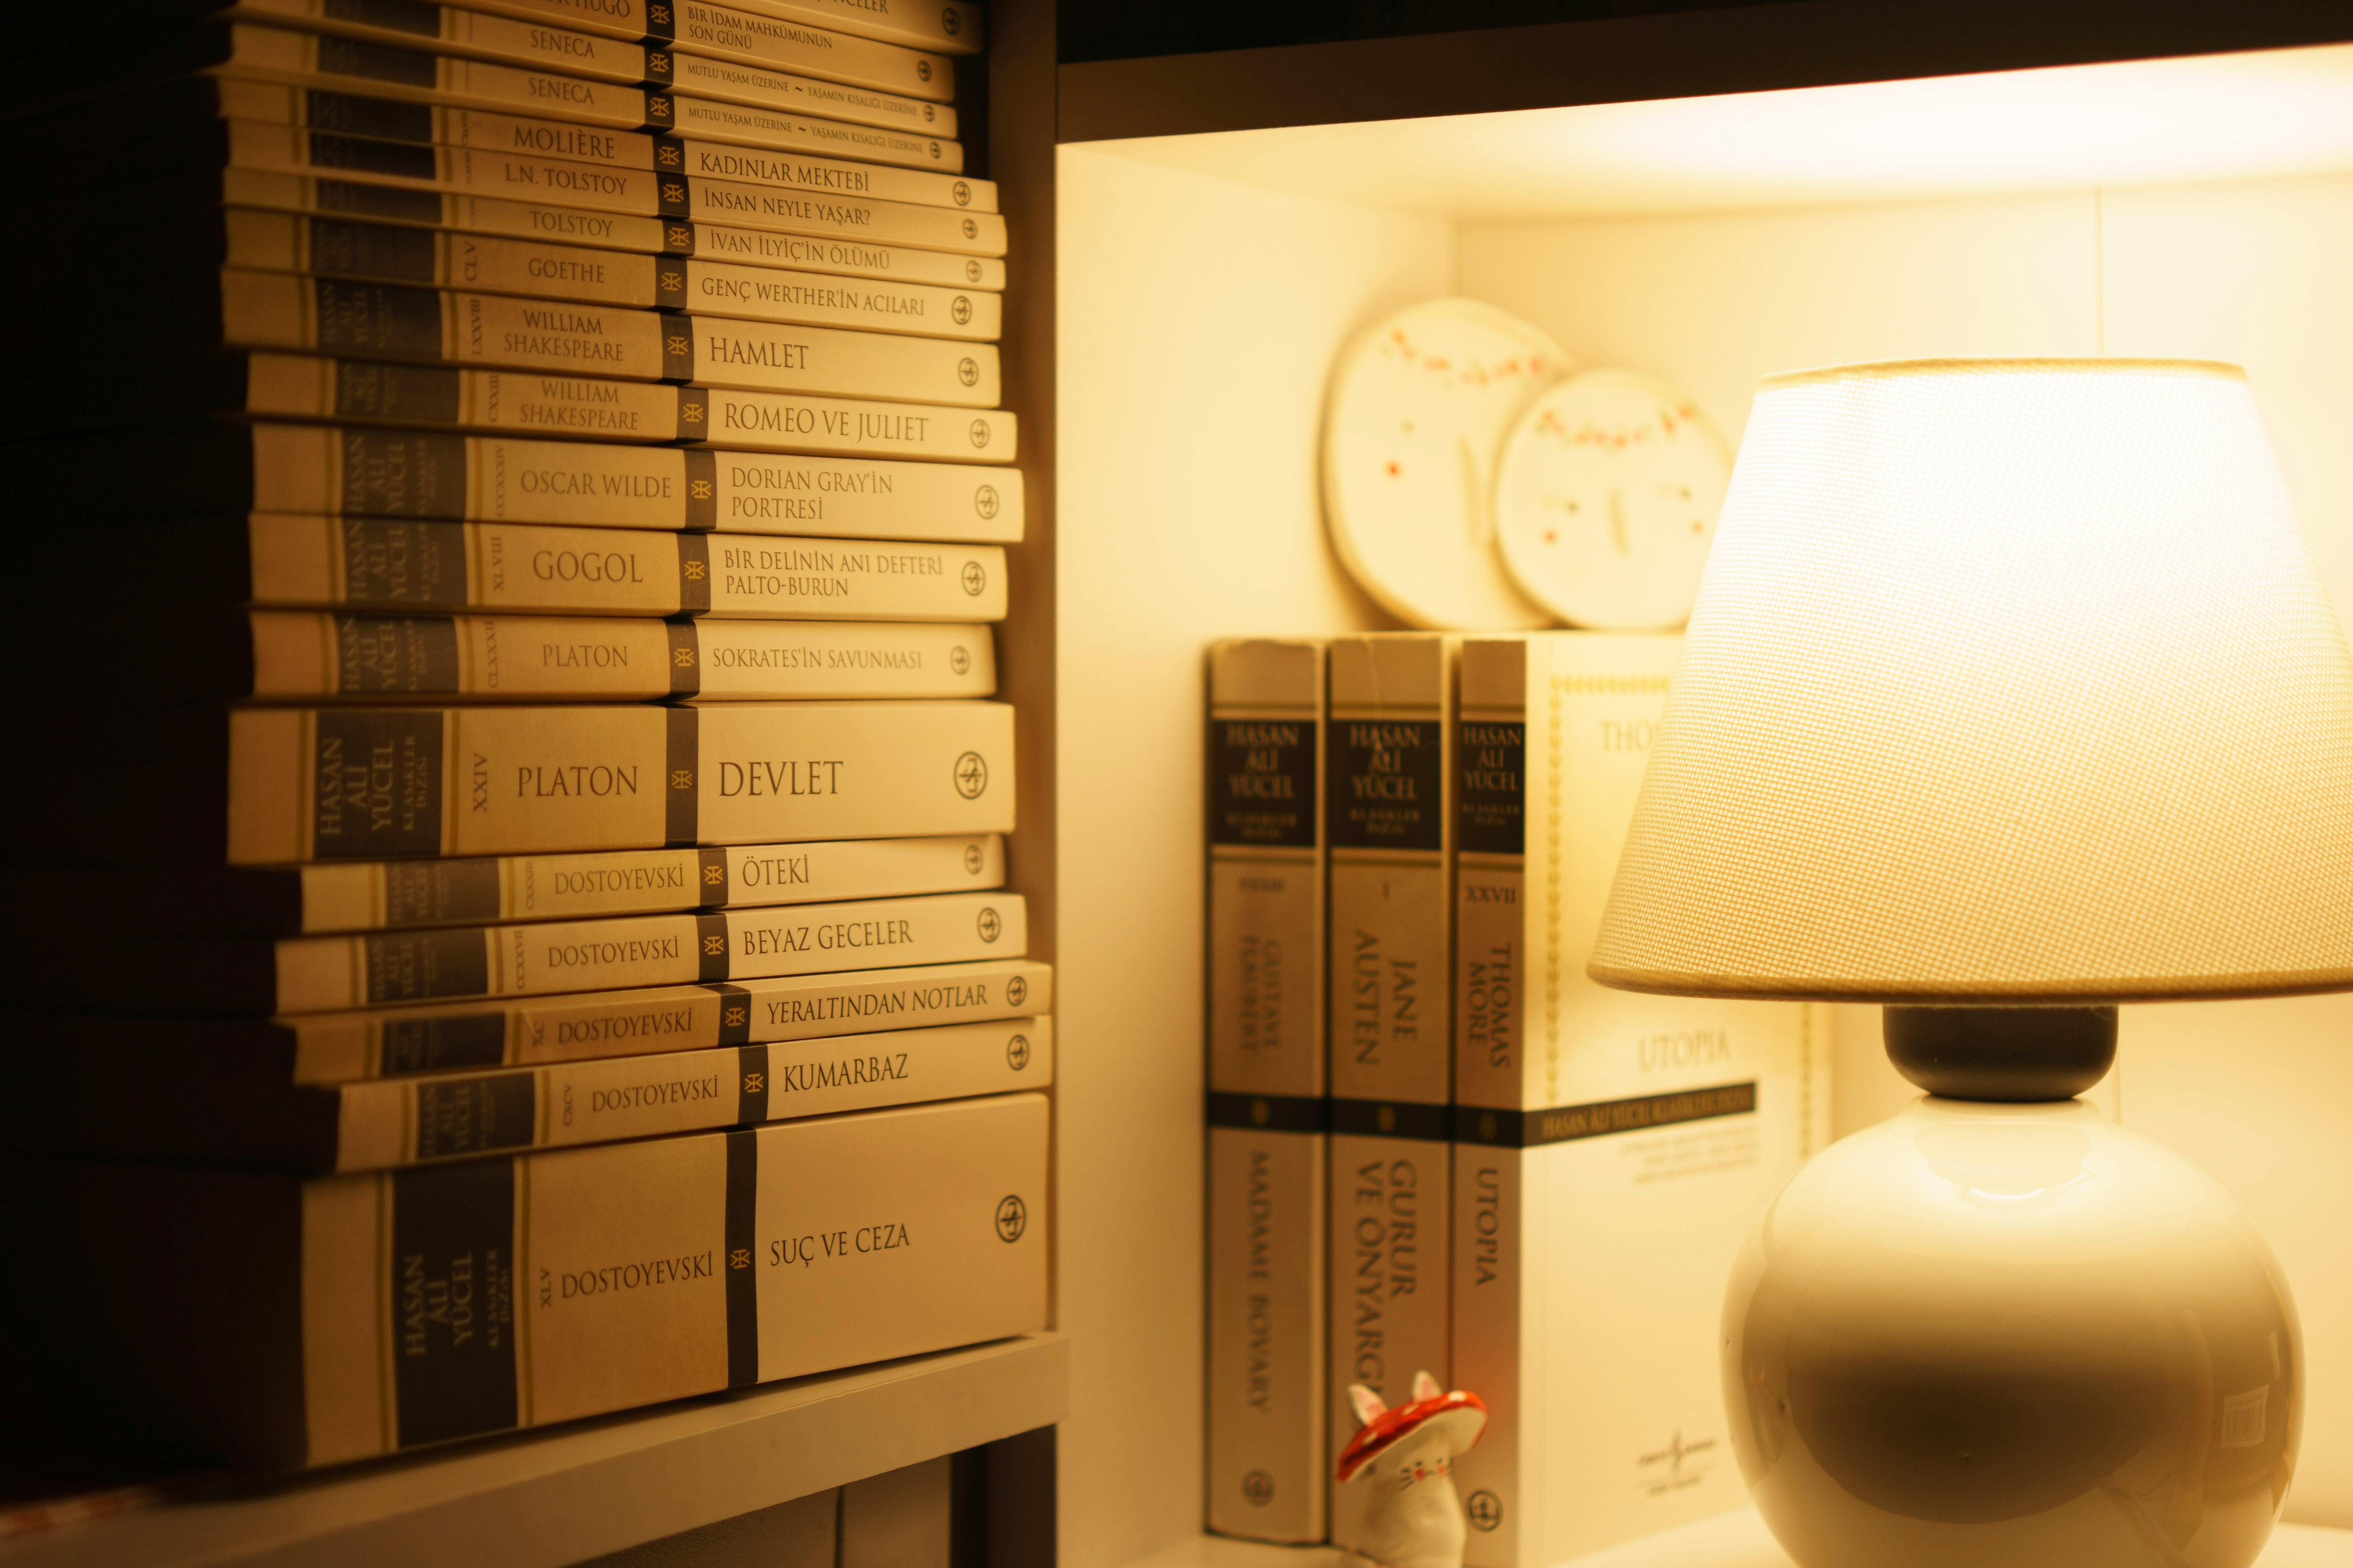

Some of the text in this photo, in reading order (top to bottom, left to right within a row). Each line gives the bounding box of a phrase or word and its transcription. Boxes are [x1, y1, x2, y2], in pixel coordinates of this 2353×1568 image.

[687, 5, 708, 23] BİR
[710, 9, 743, 30] İDAM
[530, 29, 596, 59] SENECA
[688, 24, 753, 50] SON GÜNÜ
[528, 77, 594, 104] SENECA
[687, 64, 719, 80] MUTLU
[720, 69, 750, 86] YAŞAM
[751, 74, 789, 93] ÜZERİNE
[807, 86, 845, 102] YAŞAMIN
[689, 107, 721, 122] MUTLU
[723, 111, 753, 126] YAŞAM
[754, 116, 792, 132] ÜZERİNE
[811, 126, 850, 141] YAŞAMIN
[514, 125, 615, 159] MOLIÈRE
[505, 163, 627, 195] L.N. TOLSTOY
[700, 152, 870, 192] KADINLAR MEKTEBİ
[529, 210, 613, 237] TOLSTOY
[703, 187, 871, 226] İNSAN NEYLE YAŞAR?
[464, 241, 478, 282] CLV
[710, 229, 752, 253] İVAN
[830, 244, 890, 270] ÖLÜMÜ
[528, 257, 604, 283] GOETHE
[701, 277, 925, 316] GENÇ WERTHER'İN ACILARI
[522, 309, 604, 335] WILLIAM
[504, 332, 624, 361] SHAKESPEARE
[708, 336, 810, 370] HAMLET
[541, 379, 619, 404] WILLIAM
[519, 404, 638, 430] SHAKESPEARE
[724, 402, 930, 444] ROMEO VE JULIET
[520, 469, 671, 499] OSCAR WILDE
[731, 466, 893, 494] DORIAN GRAY'İN
[731, 496, 824, 520] PORTRESİ
[532, 549, 644, 583] GOGOL
[724, 547, 943, 575] BİR DELİNİN ANI DEFTERİ
[725, 575, 849, 598] PALTO-BURUN
[542, 643, 629, 668] PLATON
[712, 646, 922, 670] SOKRATES'İN SAVUNMASI
[1462, 726, 1522, 746] HASAN
[1598, 719, 1659, 753] THO
[320, 738, 343, 835] HASAN
[473, 752, 487, 814] XXIV
[517, 765, 639, 798] PLATON
[718, 760, 844, 797] DEVLET
[554, 862, 685, 895] DOSTOYEVSKİ
[742, 853, 810, 887] ÖTEKİ
[1465, 886, 1517, 904] XXVII
[548, 935, 680, 968] DOSTOYEVSKİ
[742, 919, 915, 956] BEYAZ GECELER
[766, 983, 988, 1025] YERALTINDAN NOTLAR
[1352, 927, 1381, 1066] AUSTEN
[1386, 957, 1419, 1043] JANE
[1467, 961, 1489, 1047] MORE
[1489, 942, 1513, 1069] THOMAS
[557, 1007, 694, 1045] DOSTOYEVSKİ
[1638, 1026, 1732, 1073] UTOPIA
[783, 1052, 909, 1093] KUMARBAZ
[591, 1074, 719, 1114] DOSTOYEVSKİ
[1354, 1160, 1385, 1207] VE
[1388, 1159, 1418, 1299] GURUR
[1475, 1167, 1500, 1286] UTOPIA
[769, 1222, 911, 1268] SUÇ VE CEZA
[539, 1267, 552, 1309] XLV
[561, 1250, 714, 1299] DOSTOYEVSKİ
[402, 1253, 427, 1356] HASAN
